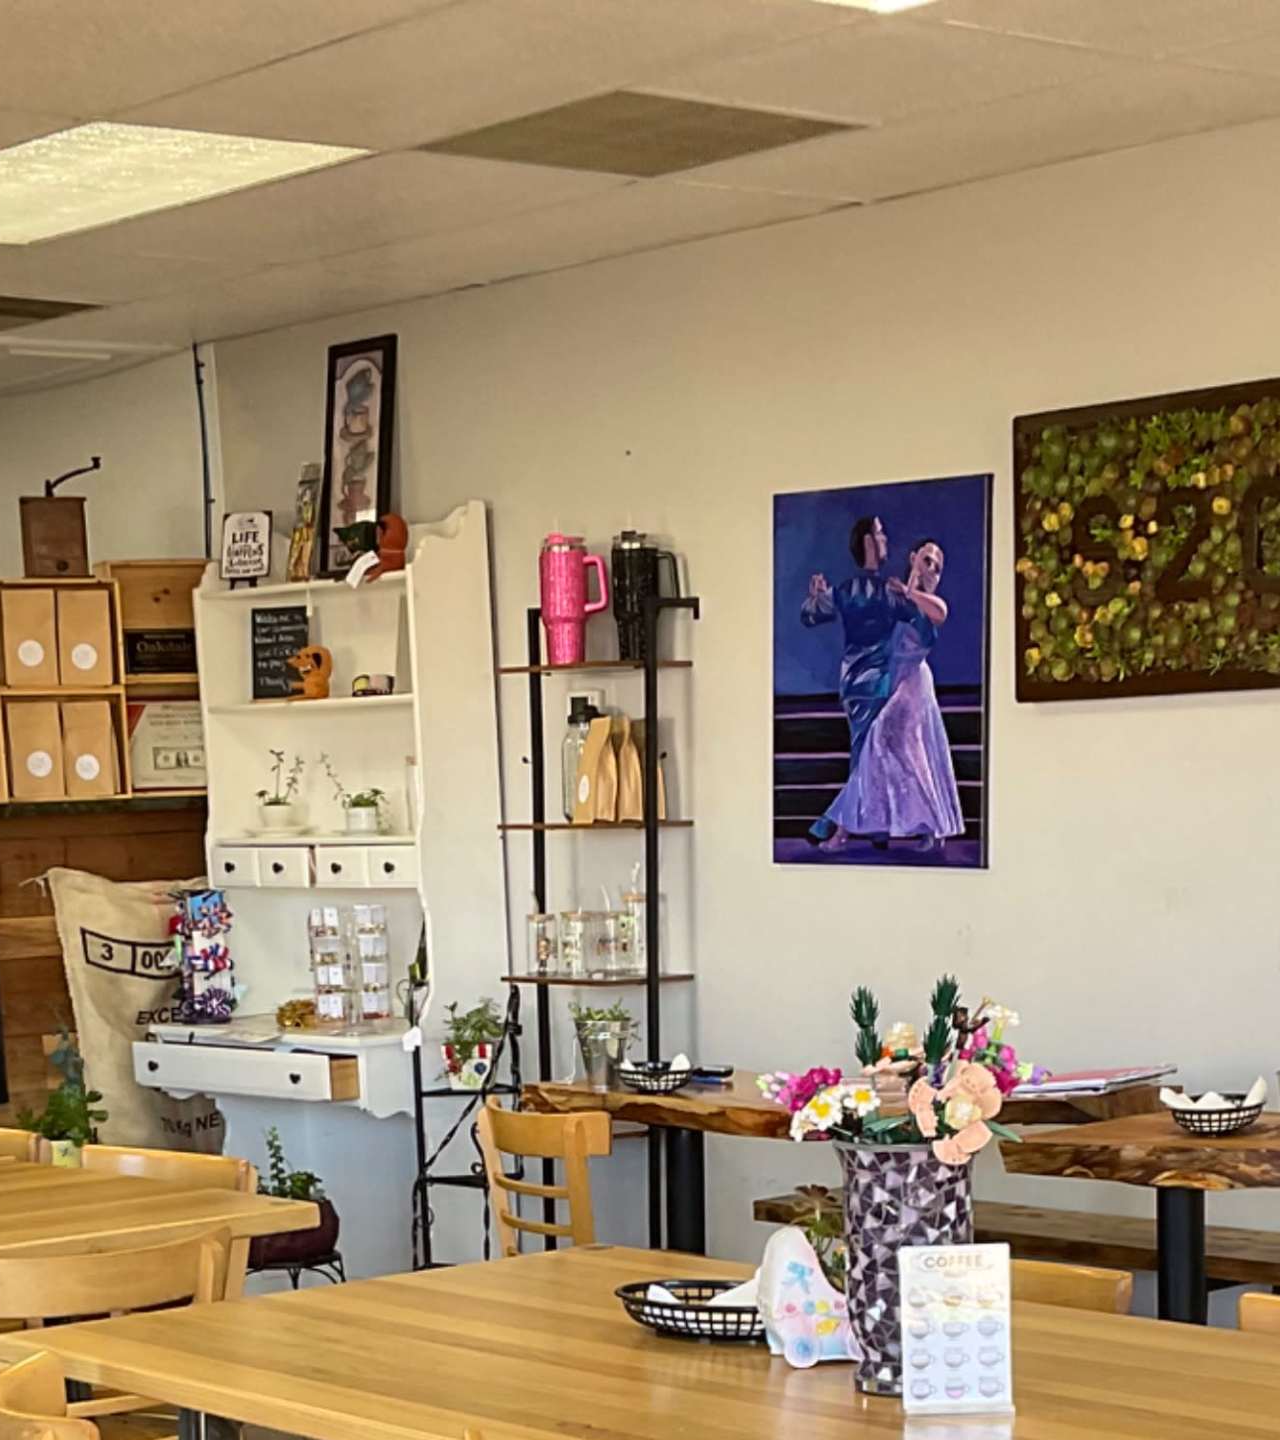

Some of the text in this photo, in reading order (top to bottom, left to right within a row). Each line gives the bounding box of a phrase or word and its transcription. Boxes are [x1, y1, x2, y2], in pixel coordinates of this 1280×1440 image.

[231, 531, 260, 544] LIFE
[100, 943, 173, 970] 3 00
[136, 1007, 185, 1026] EXCE
[923, 1253, 985, 1270] COFFEE
